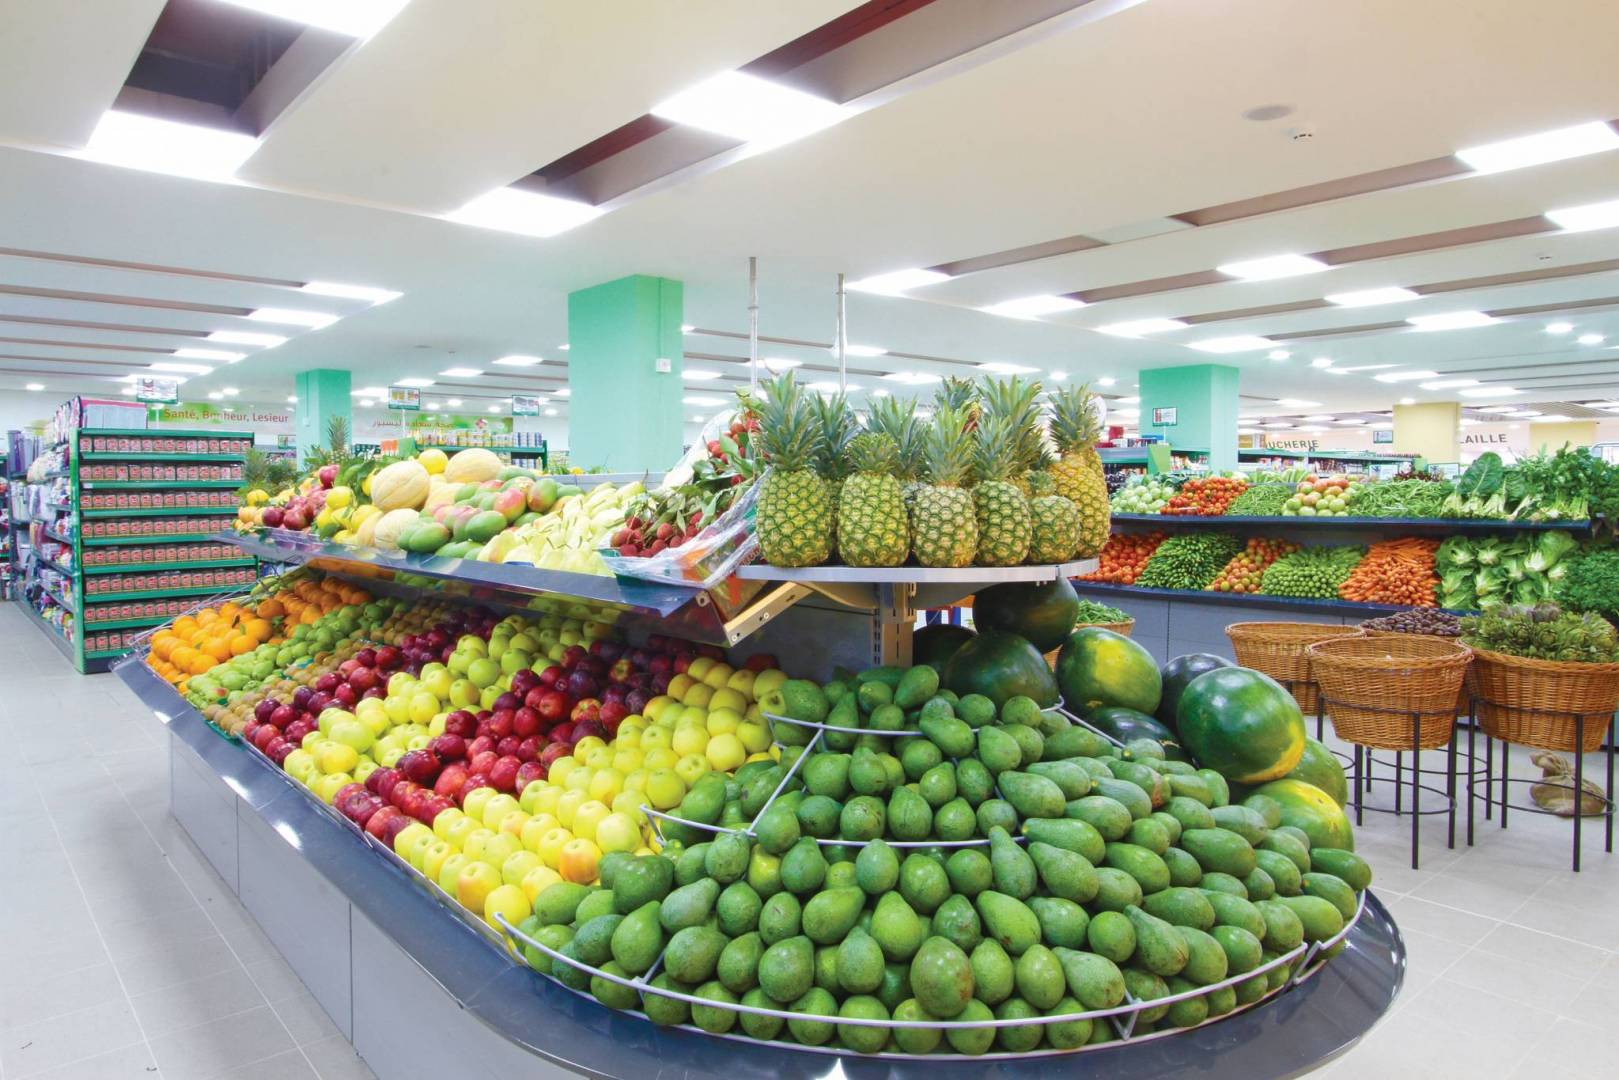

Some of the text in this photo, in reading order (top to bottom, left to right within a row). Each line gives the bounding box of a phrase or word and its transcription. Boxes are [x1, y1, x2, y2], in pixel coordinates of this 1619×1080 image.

[163, 408, 199, 420] Santé,
[252, 412, 289, 423] Lesieur
[1265, 439, 1320, 449] UCHERIE
[1459, 433, 1508, 444] AILLE
